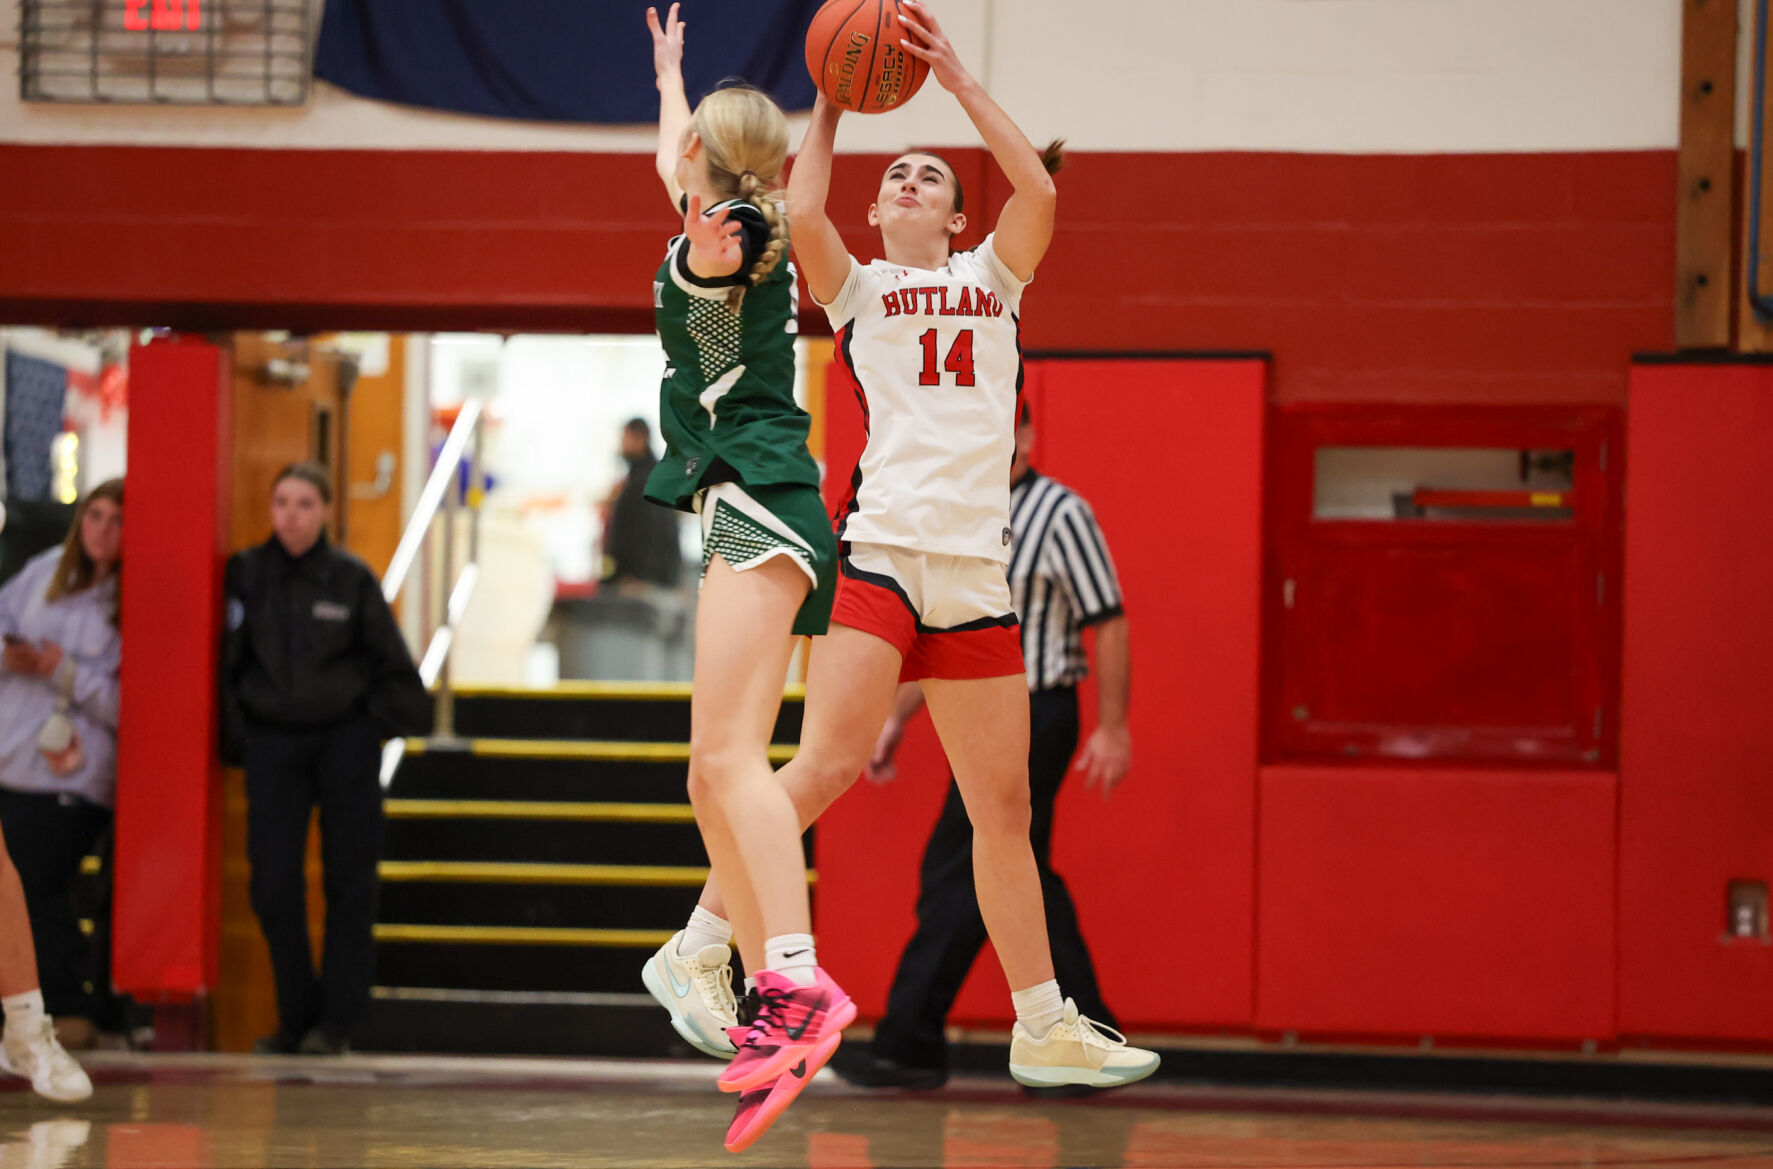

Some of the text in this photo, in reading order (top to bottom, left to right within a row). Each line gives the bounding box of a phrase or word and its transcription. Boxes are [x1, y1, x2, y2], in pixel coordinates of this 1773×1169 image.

[871, 43, 896, 109] LEGACY
[881, 286, 1004, 318] RUTLAND
[918, 328, 976, 387] 14
